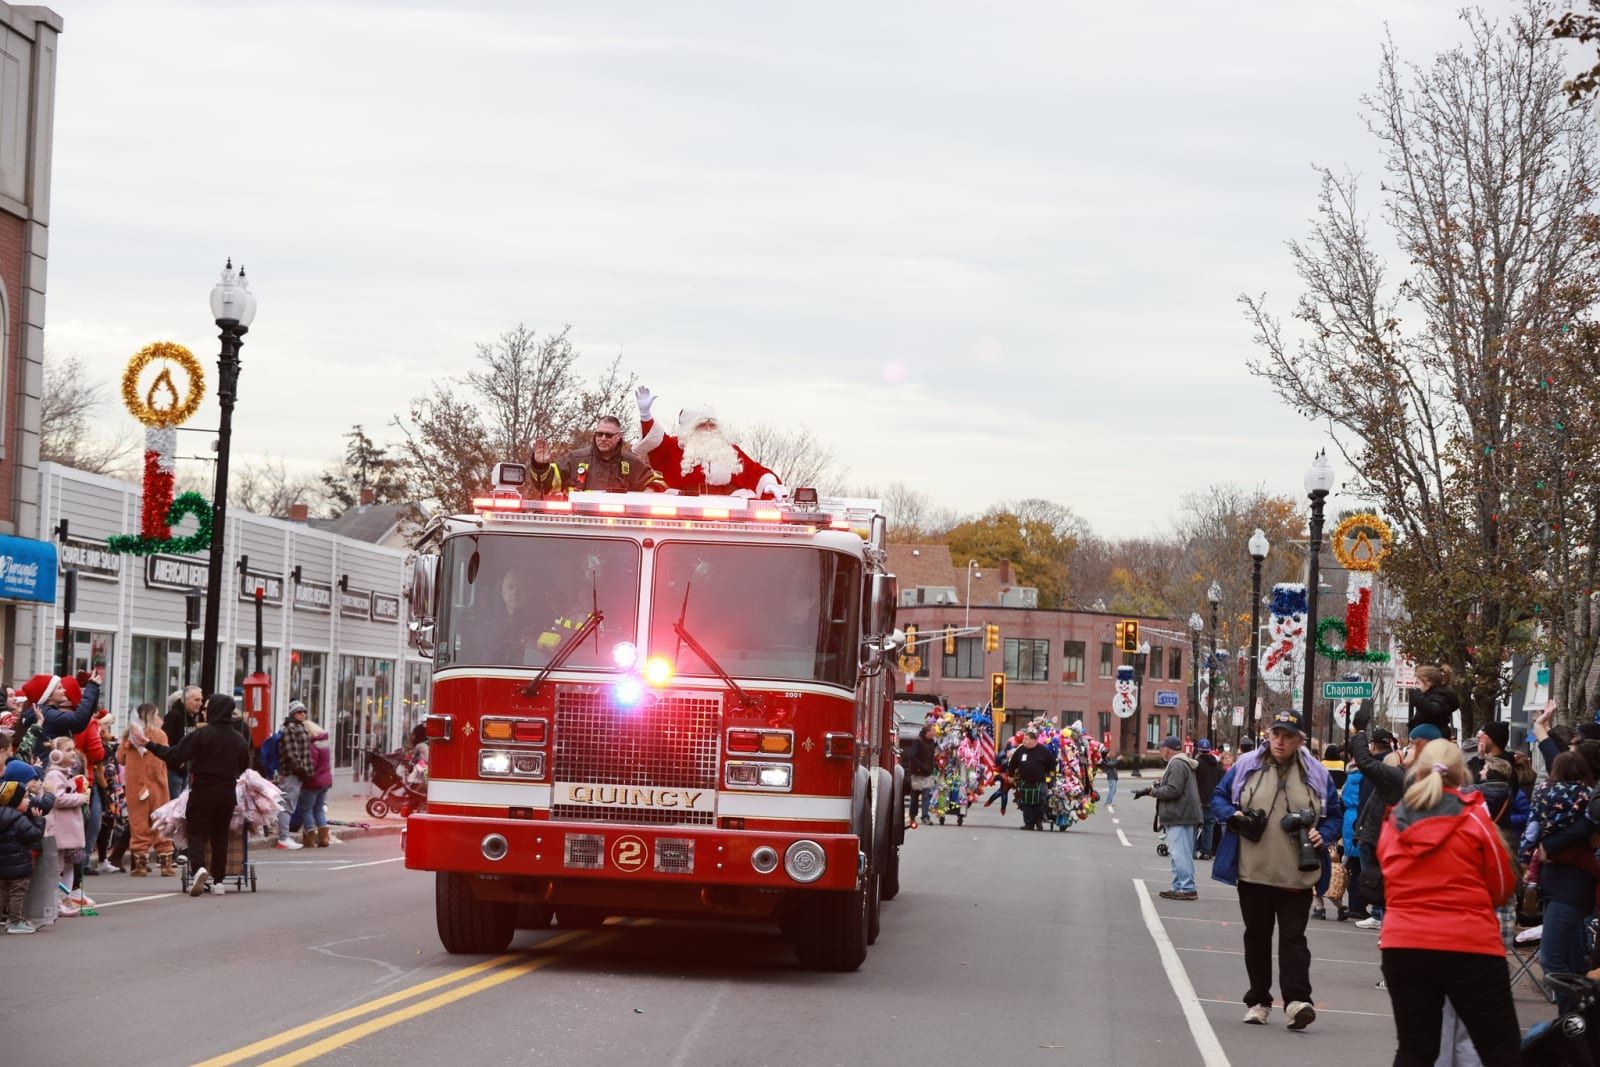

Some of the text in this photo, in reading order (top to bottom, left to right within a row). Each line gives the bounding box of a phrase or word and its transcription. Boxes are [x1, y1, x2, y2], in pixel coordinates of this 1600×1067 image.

[154, 559, 188, 584] AMERICAN
[1326, 684, 1364, 697] Chapman
[568, 785, 702, 809] QUINCY
[618, 841, 641, 865] 2
